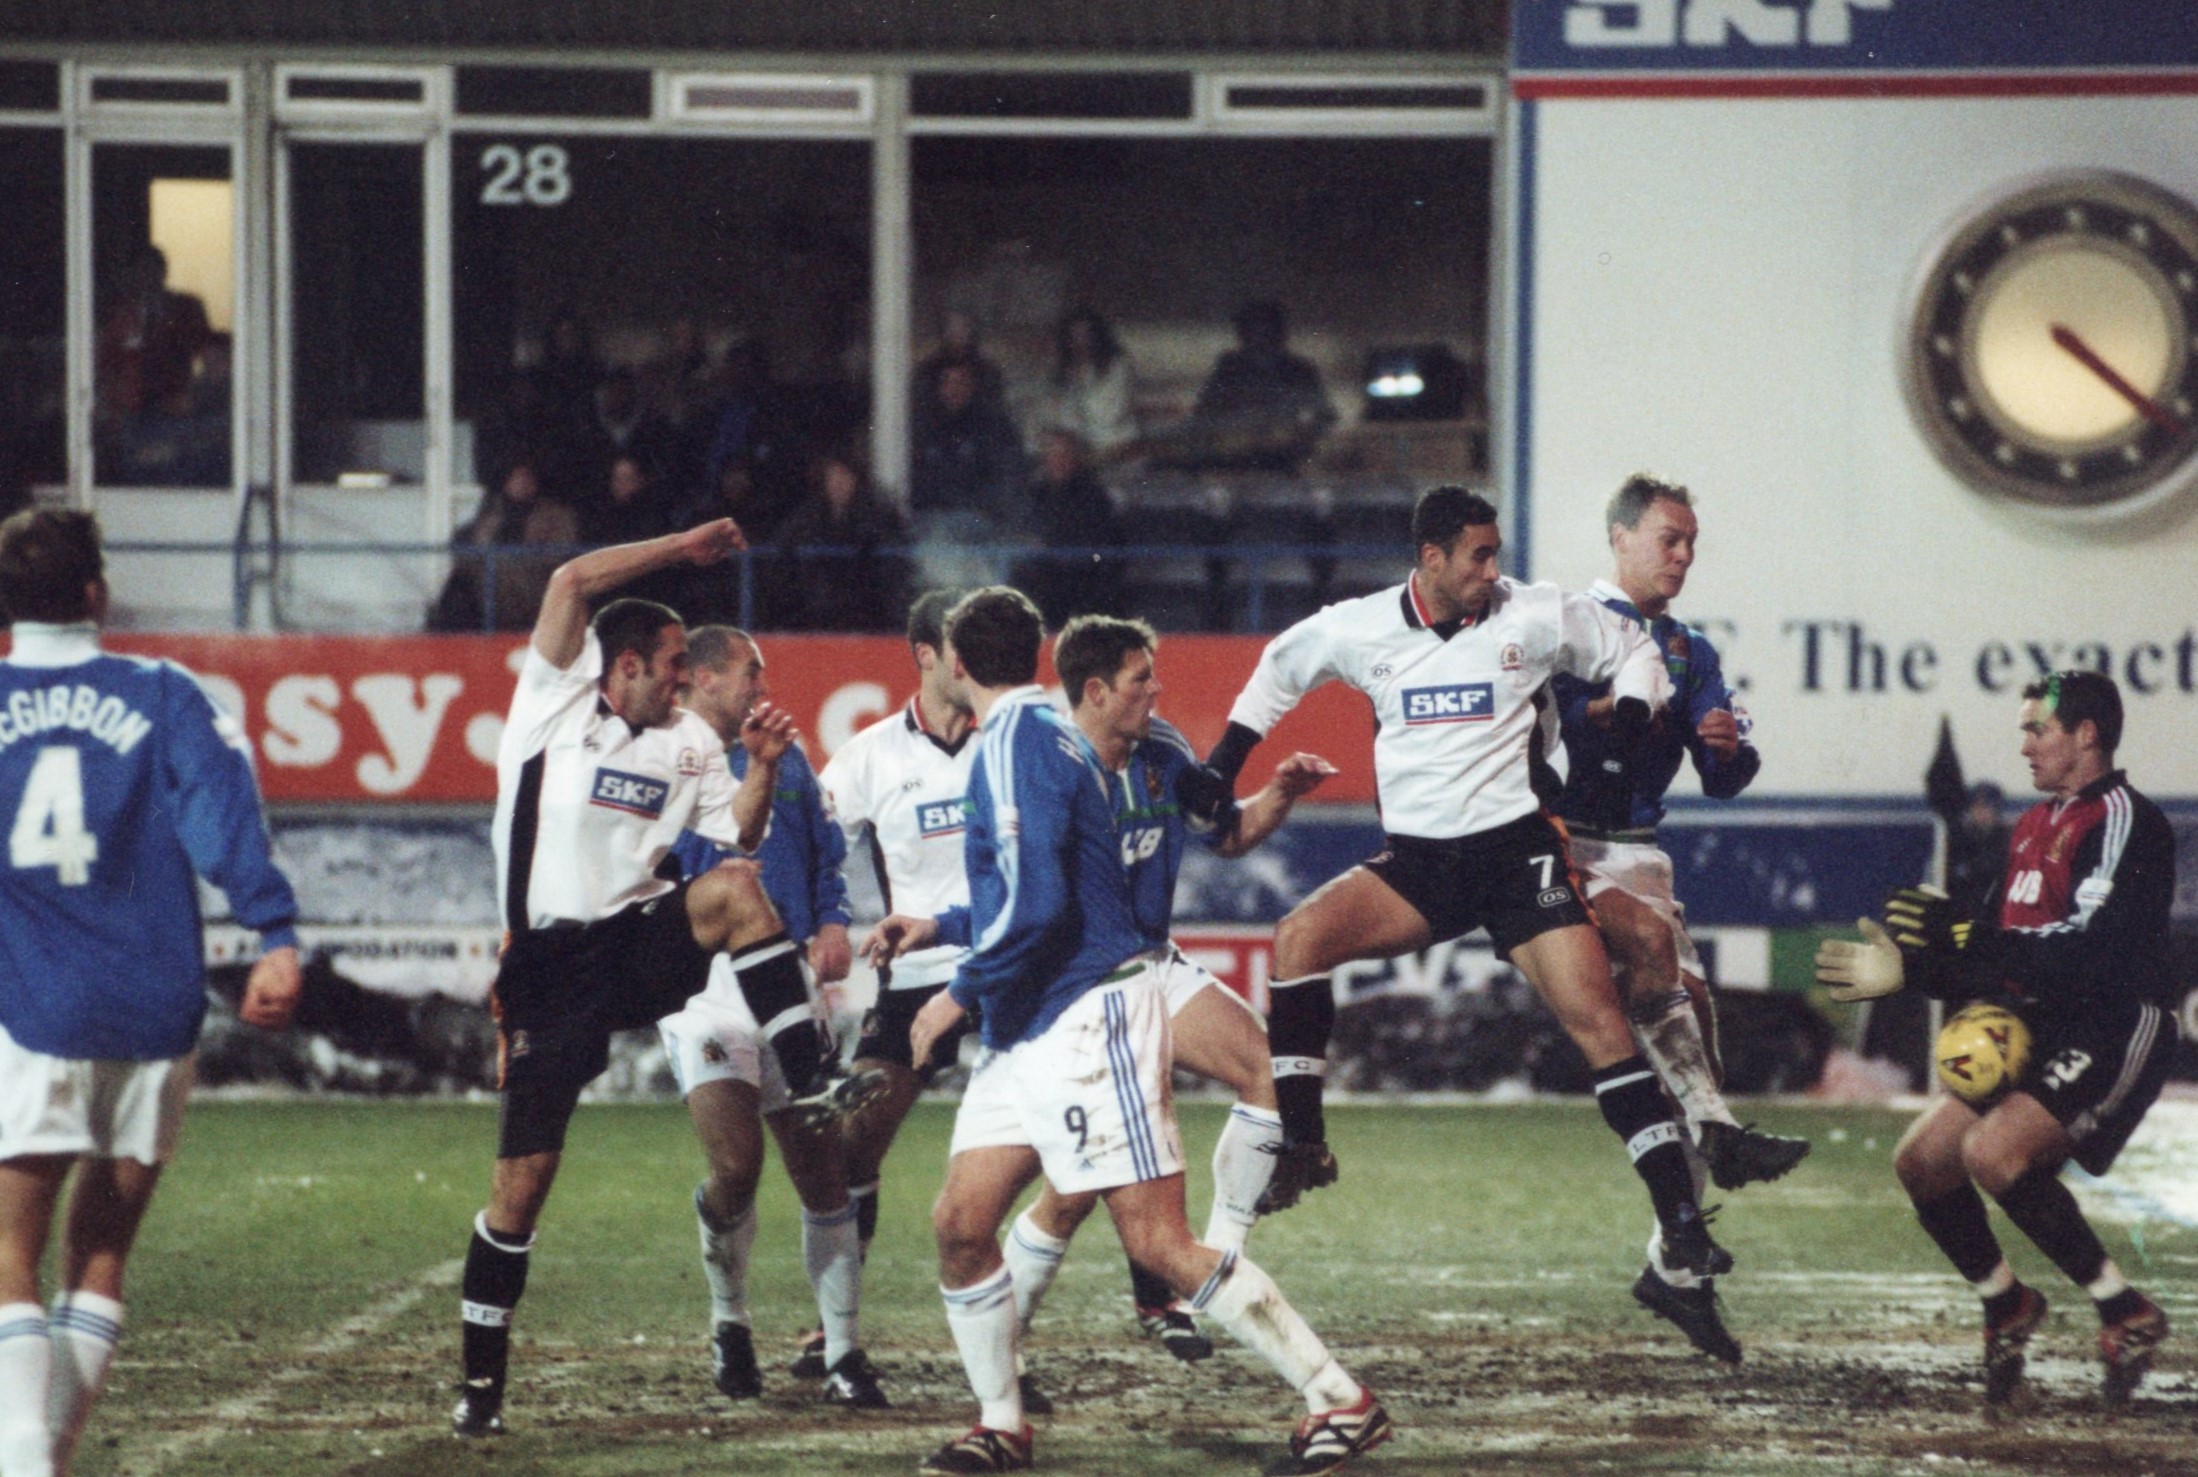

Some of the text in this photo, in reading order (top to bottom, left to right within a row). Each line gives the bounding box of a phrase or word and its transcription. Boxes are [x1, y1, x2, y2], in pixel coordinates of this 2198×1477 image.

[481, 144, 571, 205] 28
[1781, 621, 1937, 691] The
[0, 684, 153, 756] cGIBBON
[1410, 690, 1487, 716] SKF
[9, 745, 98, 886] 4
[598, 776, 664, 807] SKF
[924, 804, 966, 829] SK
[1529, 854, 1555, 889] 7
[1065, 1105, 1087, 1153] 9
